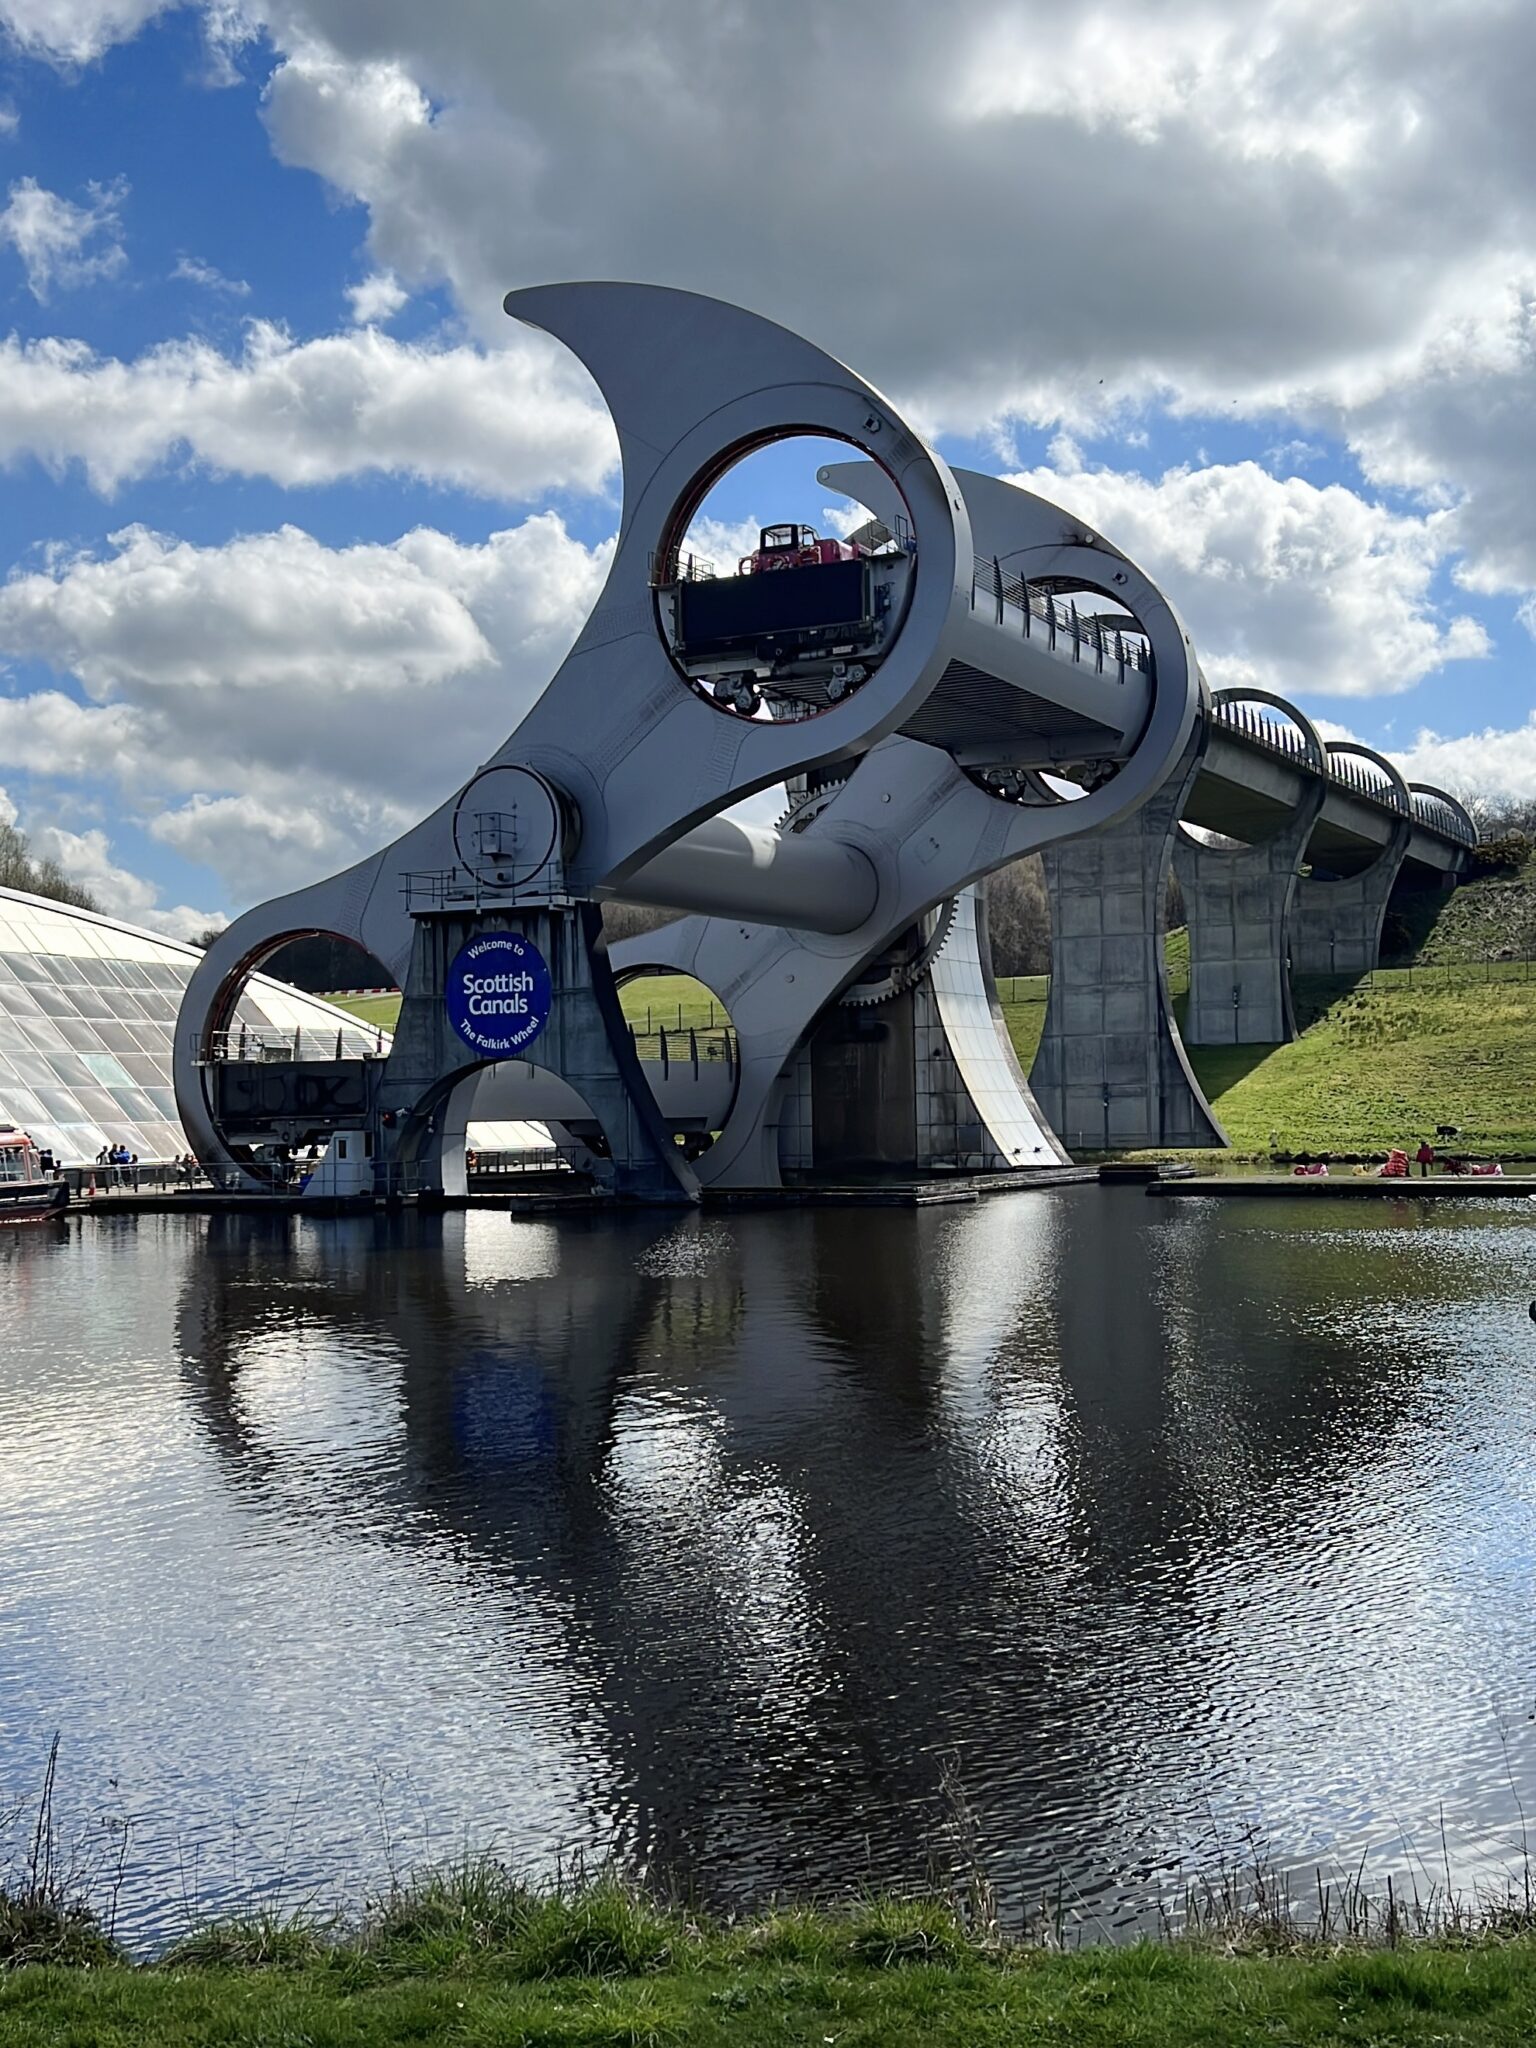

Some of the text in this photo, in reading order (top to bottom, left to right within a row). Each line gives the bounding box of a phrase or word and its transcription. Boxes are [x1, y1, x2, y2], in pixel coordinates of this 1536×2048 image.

[467, 940, 525, 959] Welcome to
[463, 971, 534, 994] Scottish
[468, 993, 528, 1015] Canals
[460, 1016, 539, 1049] The Falkirk Wheel
